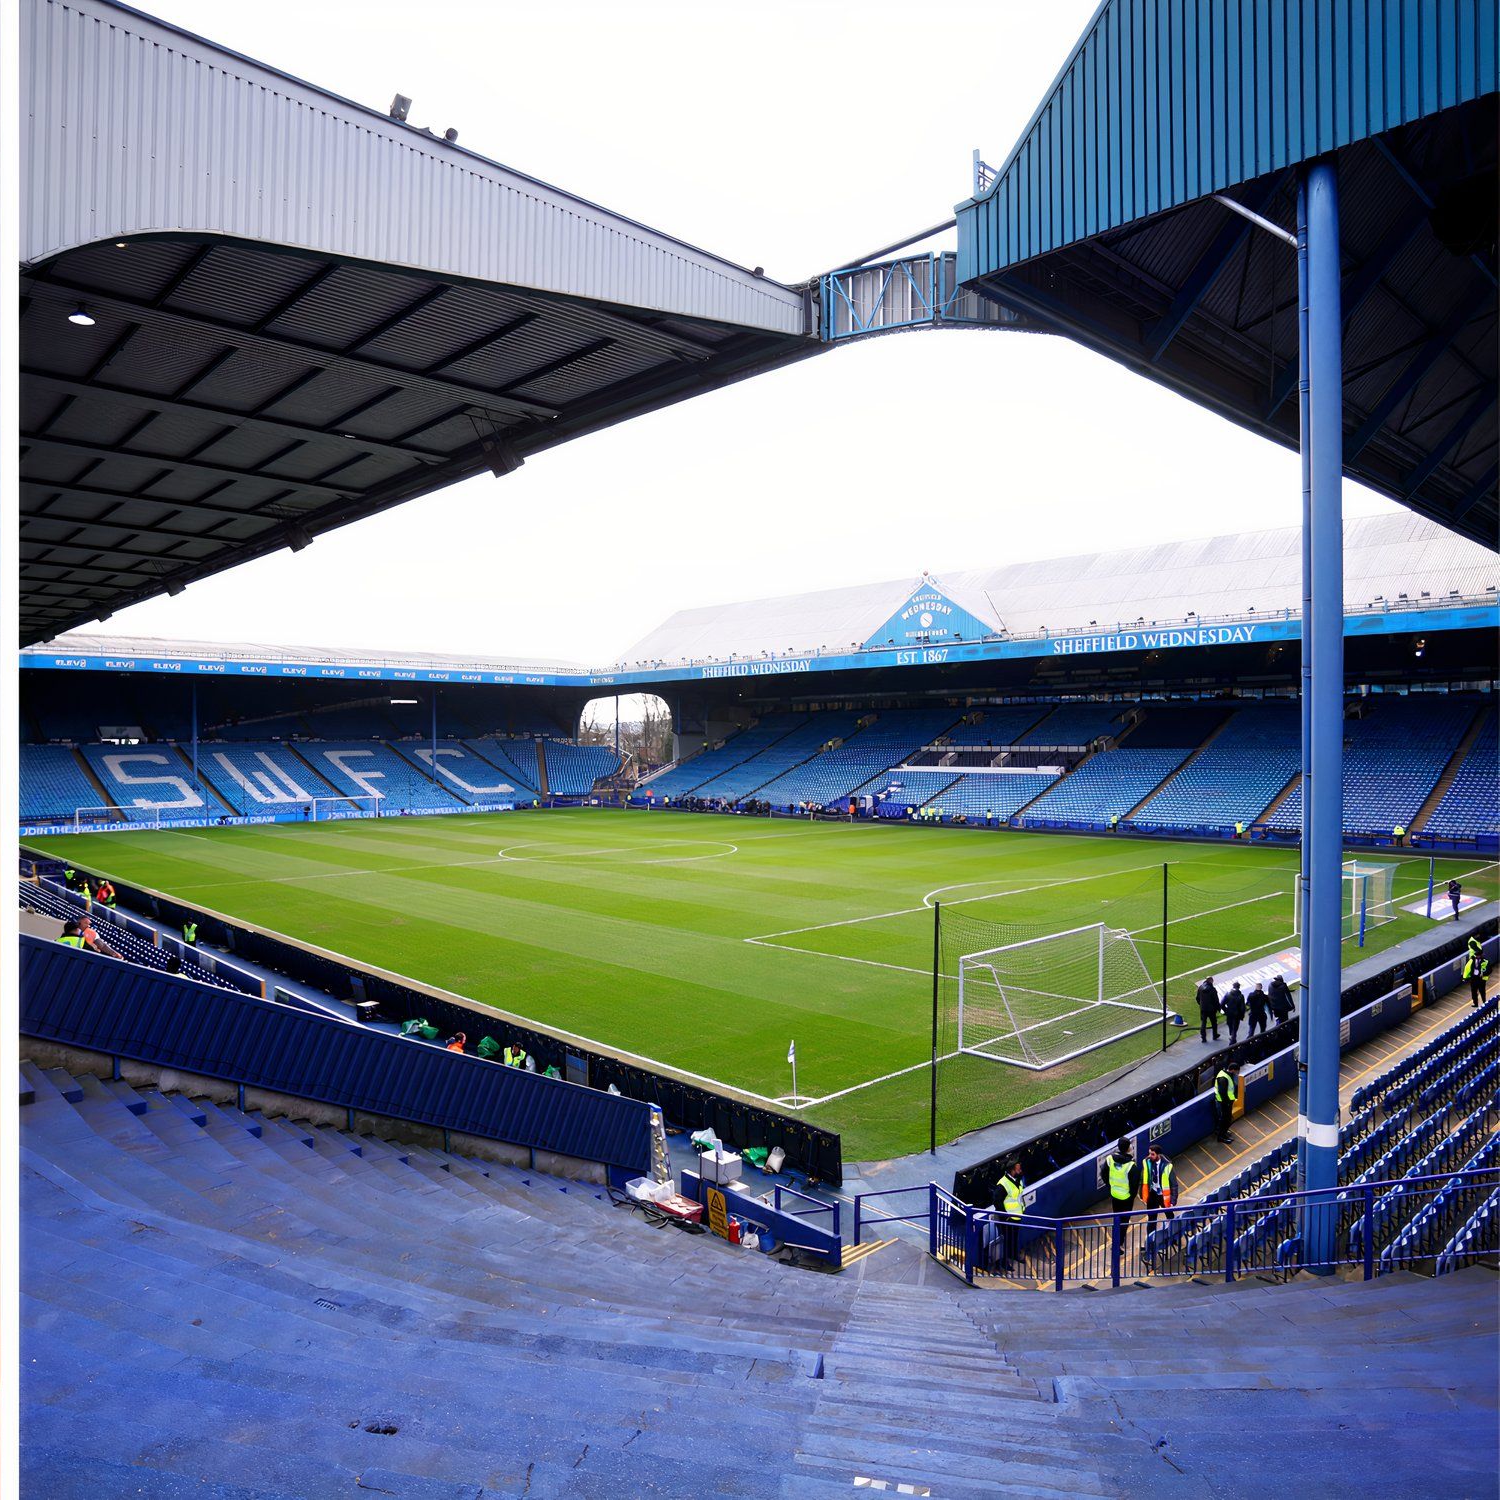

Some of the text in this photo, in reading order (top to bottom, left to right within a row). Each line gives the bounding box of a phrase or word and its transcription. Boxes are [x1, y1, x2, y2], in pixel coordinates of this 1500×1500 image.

[901, 602, 952, 621] WEDNESDAY
[1053, 625, 1256, 654] SHEFFIELD WEDNESDAY
[922, 649, 948, 662] 1867
[702, 659, 811, 679] SHEFFIELD WEDNESDAY
[101, 749, 514, 808] SWFC
[22, 827, 48, 836] JOIN
[50, 825, 70, 835] THE
[170, 817, 207, 828] WEEKLY
[250, 815, 275, 825] DRAW
